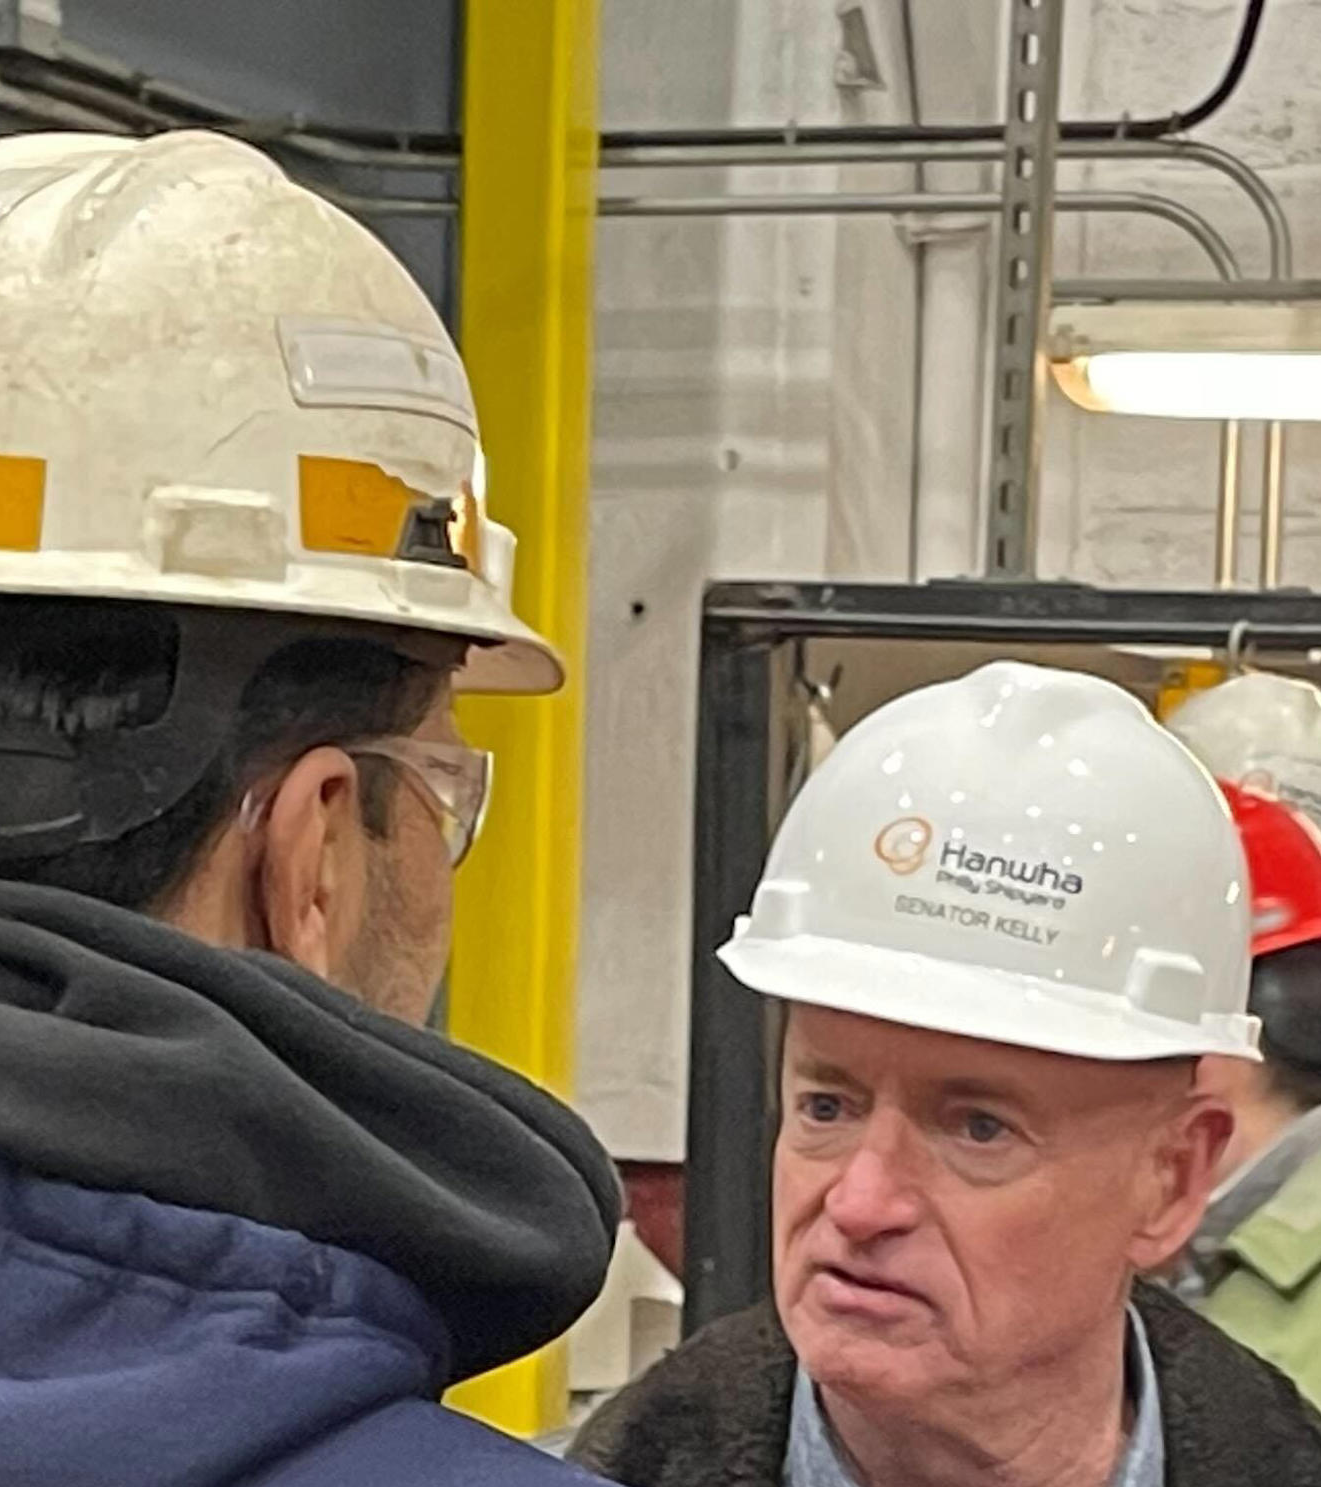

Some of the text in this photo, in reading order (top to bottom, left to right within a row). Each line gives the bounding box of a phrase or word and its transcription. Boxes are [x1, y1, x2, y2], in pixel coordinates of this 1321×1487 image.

[939, 840, 1084, 894] Hanwha
[894, 894, 1061, 945] SENATOR KELLY
